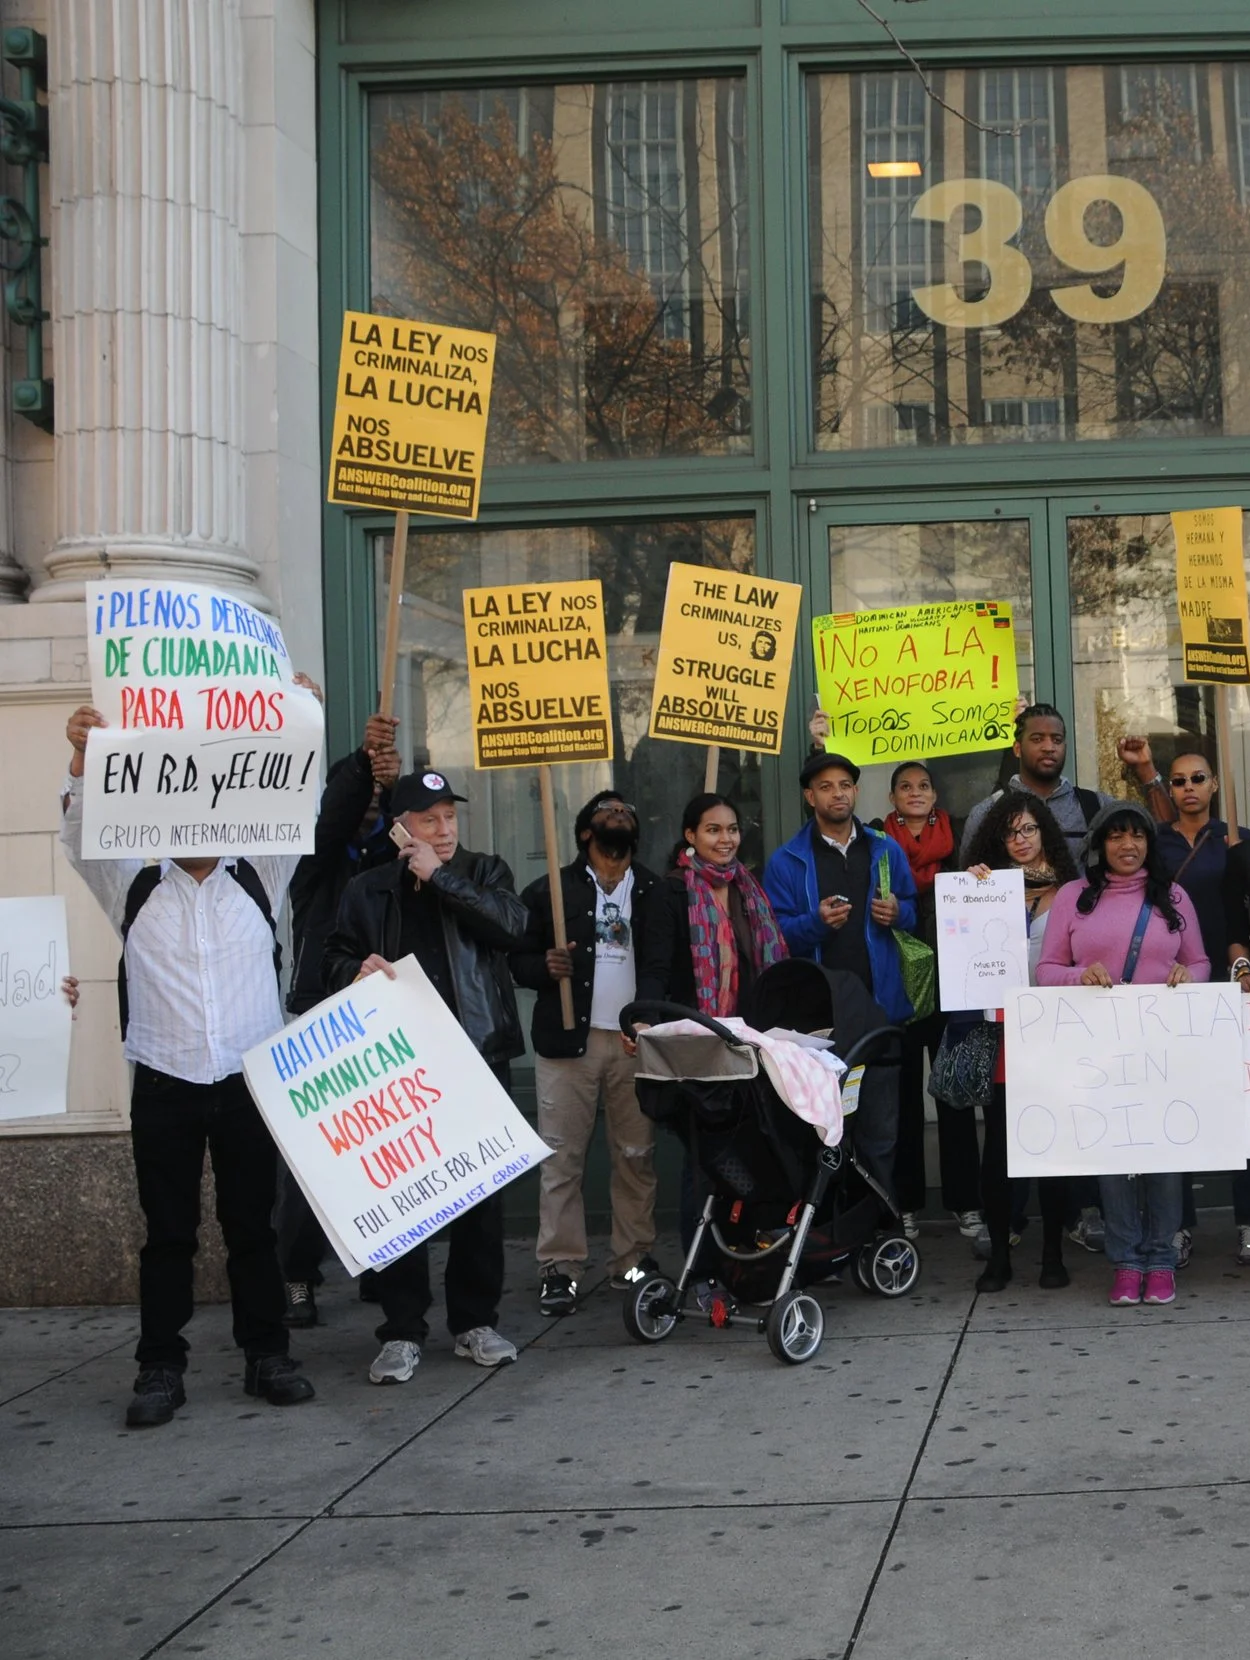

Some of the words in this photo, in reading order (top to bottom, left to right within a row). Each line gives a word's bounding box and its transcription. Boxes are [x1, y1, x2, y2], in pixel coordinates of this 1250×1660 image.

[909, 173, 1167, 329] 39
[350, 320, 382, 348] LA
[392, 328, 442, 355] LEY
[450, 343, 488, 364] NOS
[354, 350, 478, 386] CRIMINALIZA,
[344, 373, 378, 400] LA
[388, 379, 483, 415] LUCHA
[347, 414, 390, 436] NOS
[337, 434, 475, 473] ABSUELVE
[338, 466, 471, 498] ANSWERCoalition.org
[693, 580, 728, 600] THE
[734, 584, 779, 610] LAW
[1196, 576, 1206, 588] LA
[470, 596, 500, 618] LA
[508, 592, 552, 615] LEY
[560, 595, 597, 611] NOS
[680, 602, 782, 632] CRIMINALIZES
[856, 610, 908, 624] DOMINICAN
[1180, 600, 1212, 618] MADRE
[210, 596, 287, 658] DERECHOS
[478, 616, 591, 637] CRIMINALIZA,
[718, 631, 742, 650] US,
[104, 636, 134, 678] DE
[143, 636, 282, 681] CIUDADANÍA
[474, 644, 504, 668] LA
[512, 638, 601, 665] LUCHA
[897, 634, 918, 664] A
[944, 626, 985, 657] LA
[672, 658, 776, 689] STRUGGLE
[834, 669, 975, 705] XENOFOBIA
[481, 682, 520, 700] NOS
[706, 686, 740, 703] WILL
[122, 686, 184, 730] PARA
[198, 686, 284, 732] TODOS
[477, 696, 602, 724] ABSUELVE
[658, 694, 747, 723] ABSOLVE
[753, 708, 779, 728] US
[932, 701, 1012, 725] SOMOS
[482, 728, 604, 748] ANSWERCoalition.org
[658, 716, 774, 744] ANSWERCoalition.org
[104, 751, 144, 794] EN
[157, 753, 199, 794] R.D.
[100, 824, 161, 849] GRUPO
[170, 823, 302, 846] INTERNACIONALISTA
[974, 960, 1006, 970] MUERTO
[978, 970, 996, 978] CIVIL
[1016, 992, 1243, 1043] PATRIA
[288, 1026, 416, 1119] DOMINICAN
[1073, 1048, 1168, 1089] SIN
[318, 1068, 442, 1156] WORKERS
[1016, 1100, 1200, 1156] ODIO
[360, 1116, 442, 1190] UNITY
[353, 1204, 392, 1238] FULL
[390, 1169, 448, 1216] RIGHTS
[444, 1151, 478, 1183] FOR
[480, 1126, 516, 1165] ALL!
[368, 1182, 488, 1264] INTERNATIONALIST
[492, 1153, 531, 1186] GROUP
